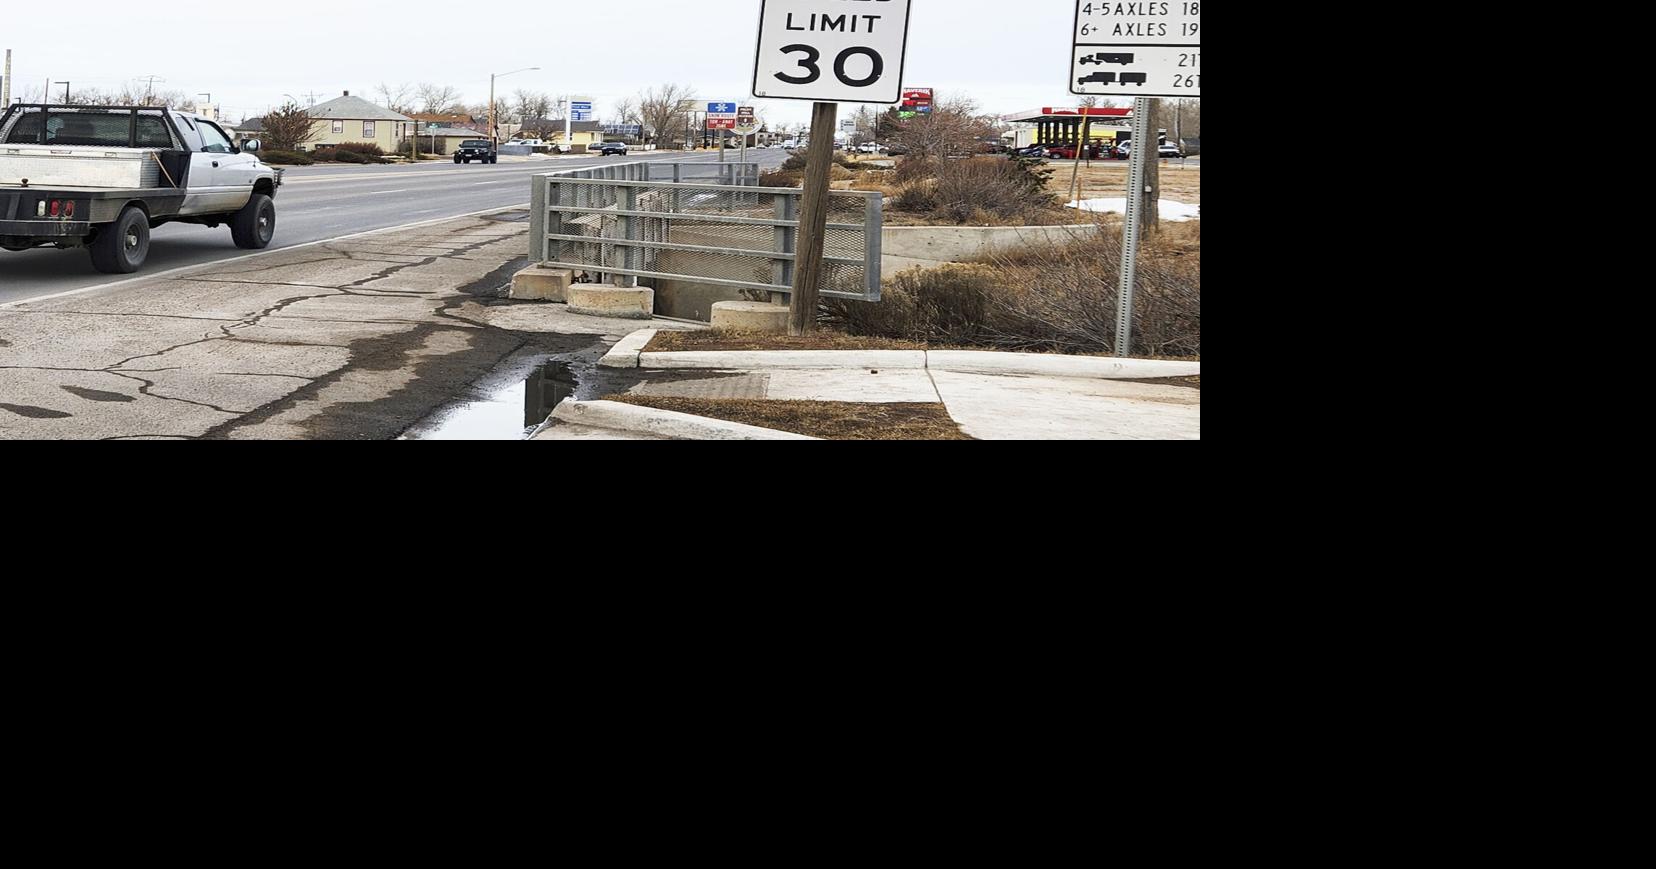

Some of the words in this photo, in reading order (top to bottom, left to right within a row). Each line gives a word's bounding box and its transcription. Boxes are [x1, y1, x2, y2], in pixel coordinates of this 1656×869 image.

[1113, 2, 1169, 15] AXLES
[786, 12, 882, 33] LIMIT
[1081, 23, 1098, 36] 6+
[1112, 23, 1167, 36] AXLES
[773, 43, 884, 88] 30
